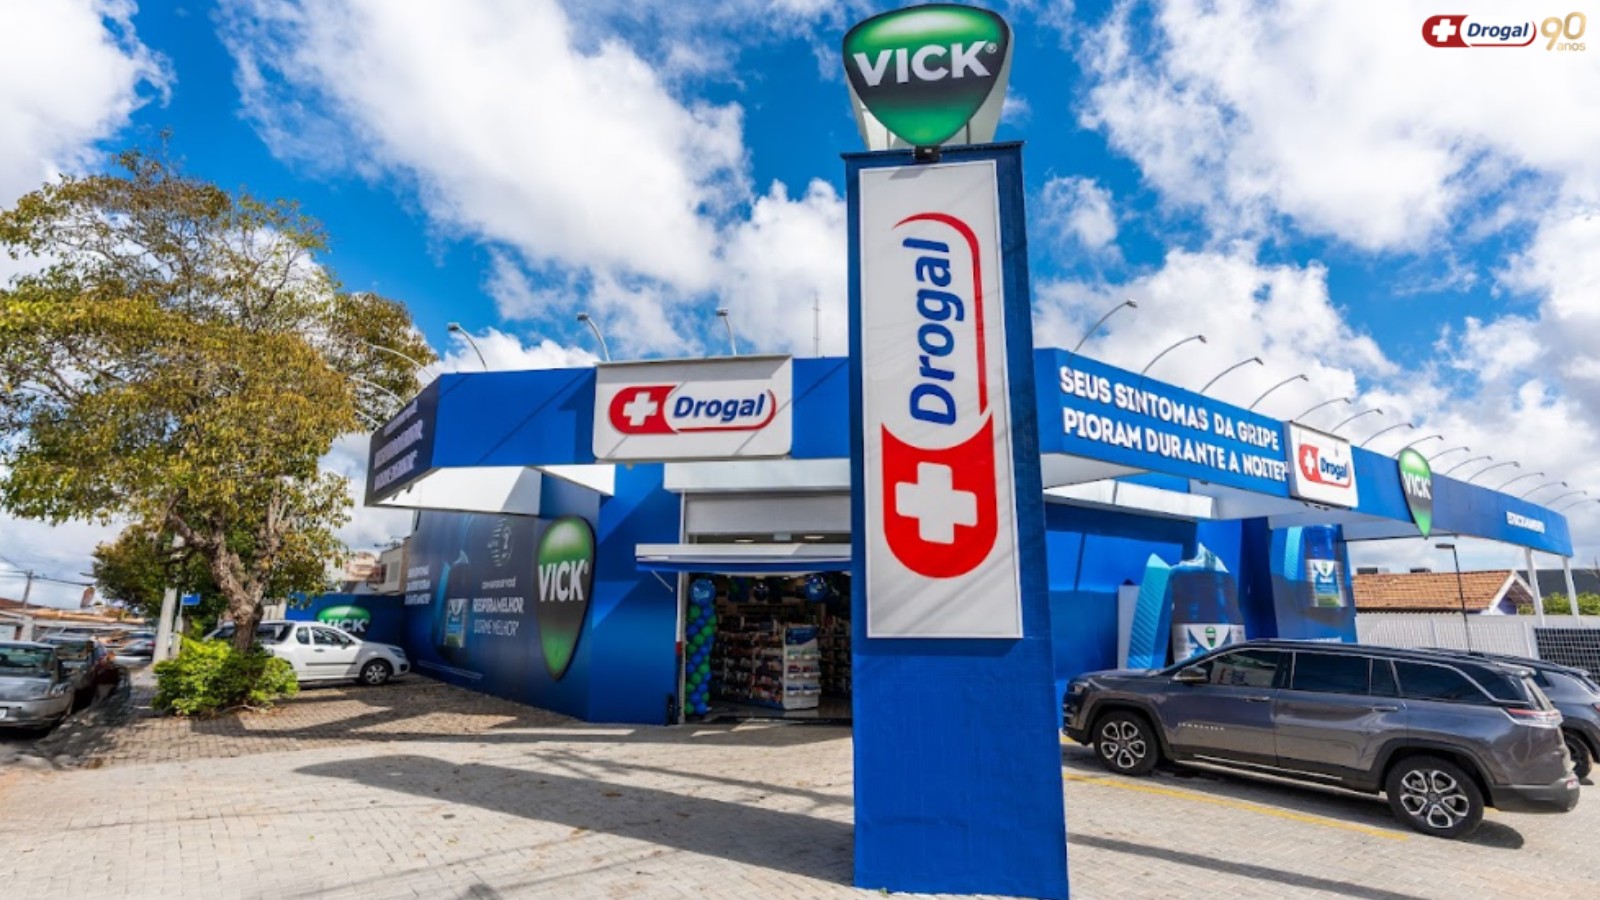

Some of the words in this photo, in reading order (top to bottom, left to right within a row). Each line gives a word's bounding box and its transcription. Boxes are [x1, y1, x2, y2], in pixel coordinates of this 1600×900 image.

[902, 237, 964, 426] Drogal
[673, 393, 765, 423] Drogal
[1059, 366, 1112, 404] SEUS
[1114, 383, 1210, 431] SINTOMAS
[1213, 412, 1235, 440] DA
[1237, 421, 1280, 451] GRIPE
[1062, 407, 1143, 451] PIORAM
[1145, 428, 1226, 470] DURANTE
[1228, 450, 1241, 473] A
[1320, 456, 1349, 480] Drogal
[1403, 471, 1432, 500] VICK
